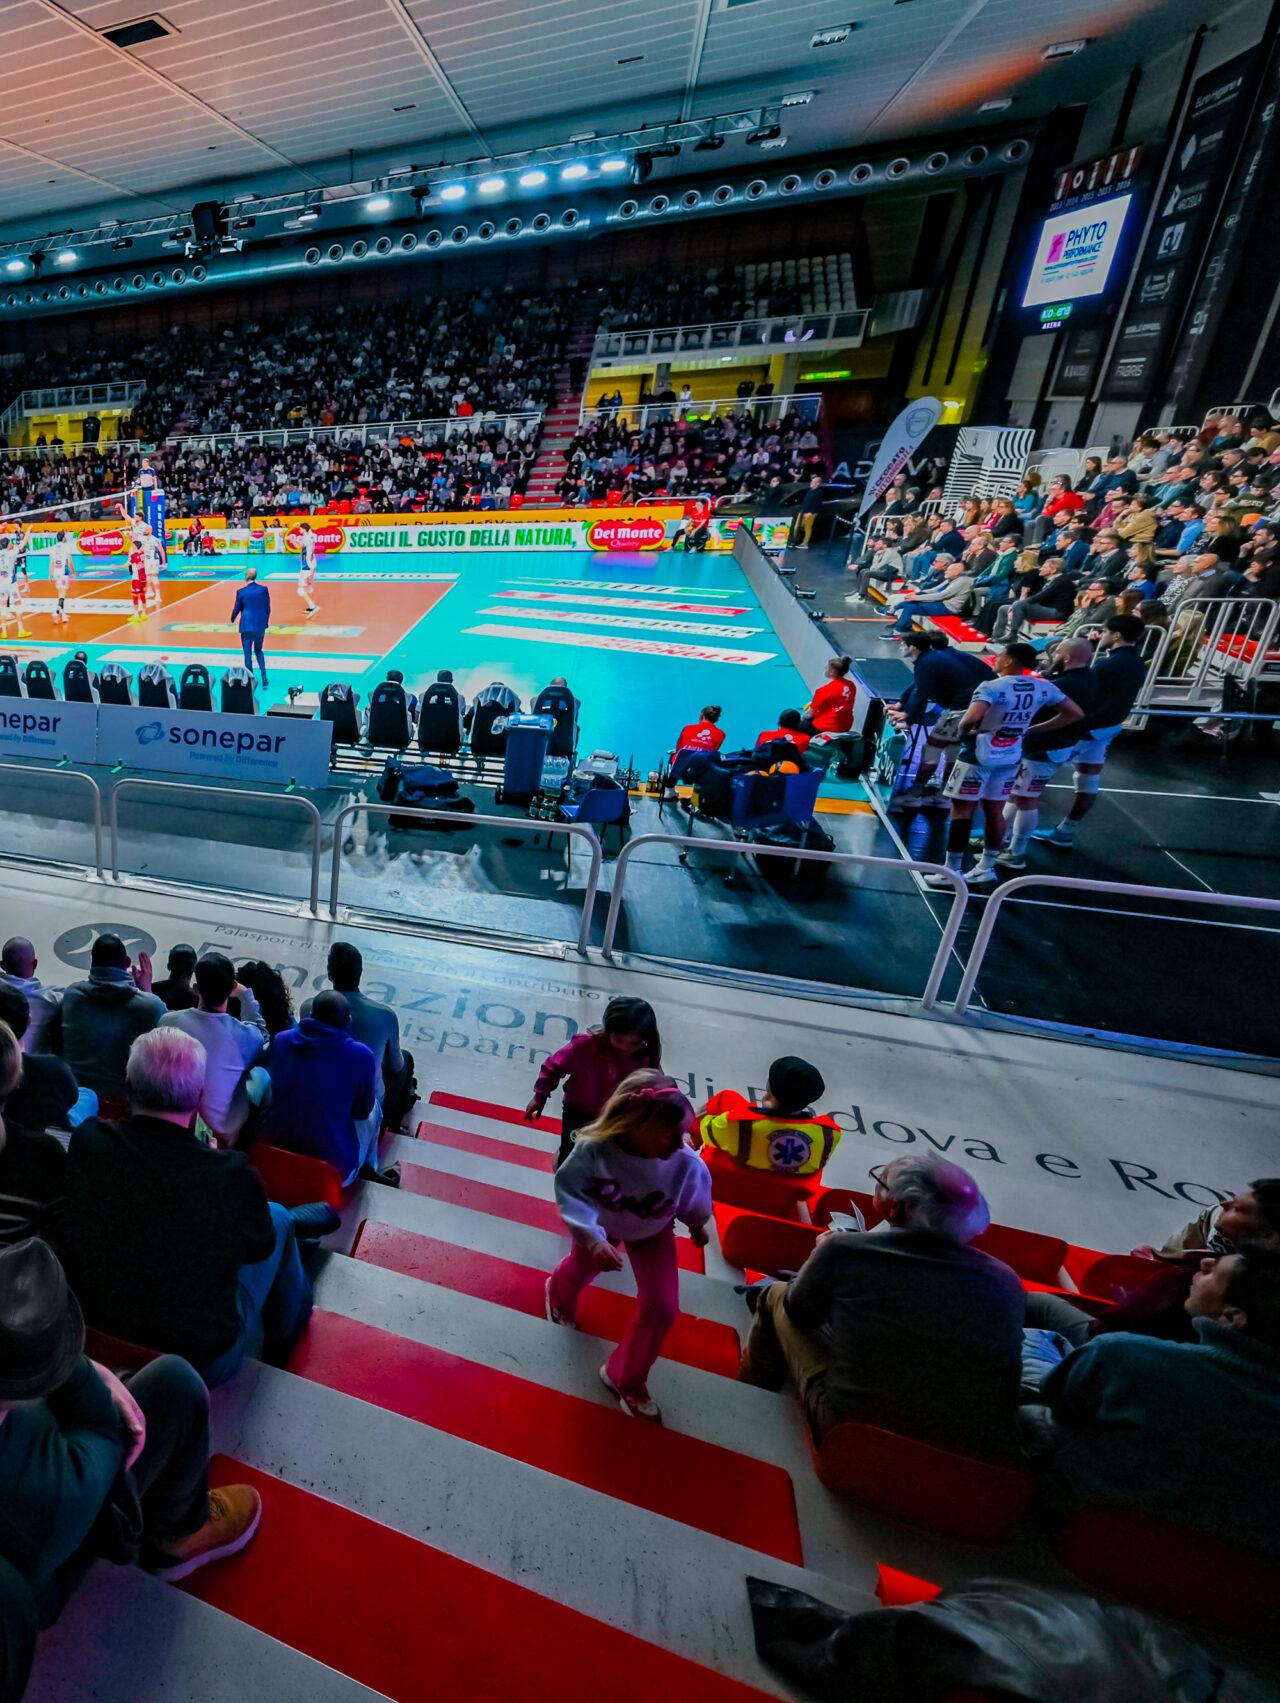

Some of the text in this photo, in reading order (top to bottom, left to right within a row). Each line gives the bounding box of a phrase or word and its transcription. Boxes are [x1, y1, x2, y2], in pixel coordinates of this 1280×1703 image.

[1065, 220, 1108, 247] PHYTO
[874, 446, 906, 487] CECCATO
[80, 536, 124, 546] Del Monte
[350, 528, 577, 548] SCEGLI IL GUSTO DELLA NATURA,
[593, 526, 662, 540] Del Monte
[1012, 693, 1033, 711] 10
[1003, 711, 1032, 722] ITAS
[169, 726, 286, 754] sonepar
[235, 754, 278, 768] Difference
[1035, 1152, 1082, 1178] e
